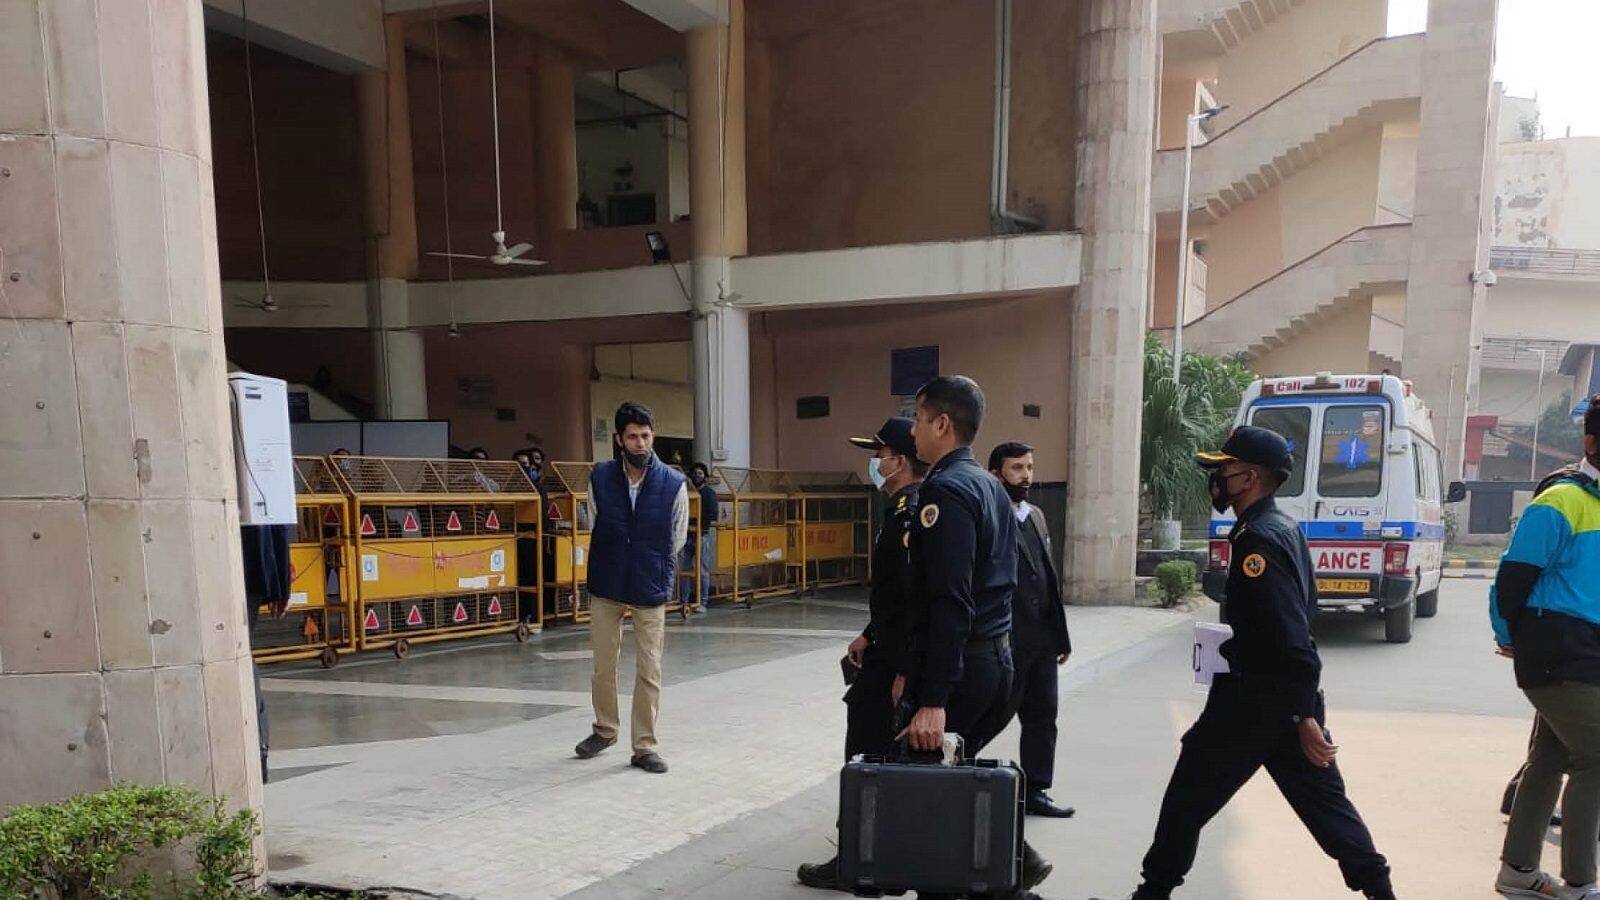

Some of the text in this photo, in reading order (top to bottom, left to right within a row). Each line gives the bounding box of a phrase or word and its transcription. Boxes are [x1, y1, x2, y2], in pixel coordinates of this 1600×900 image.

[1277, 377, 1366, 391] Call 102
[1317, 551, 1371, 570] ANCE
